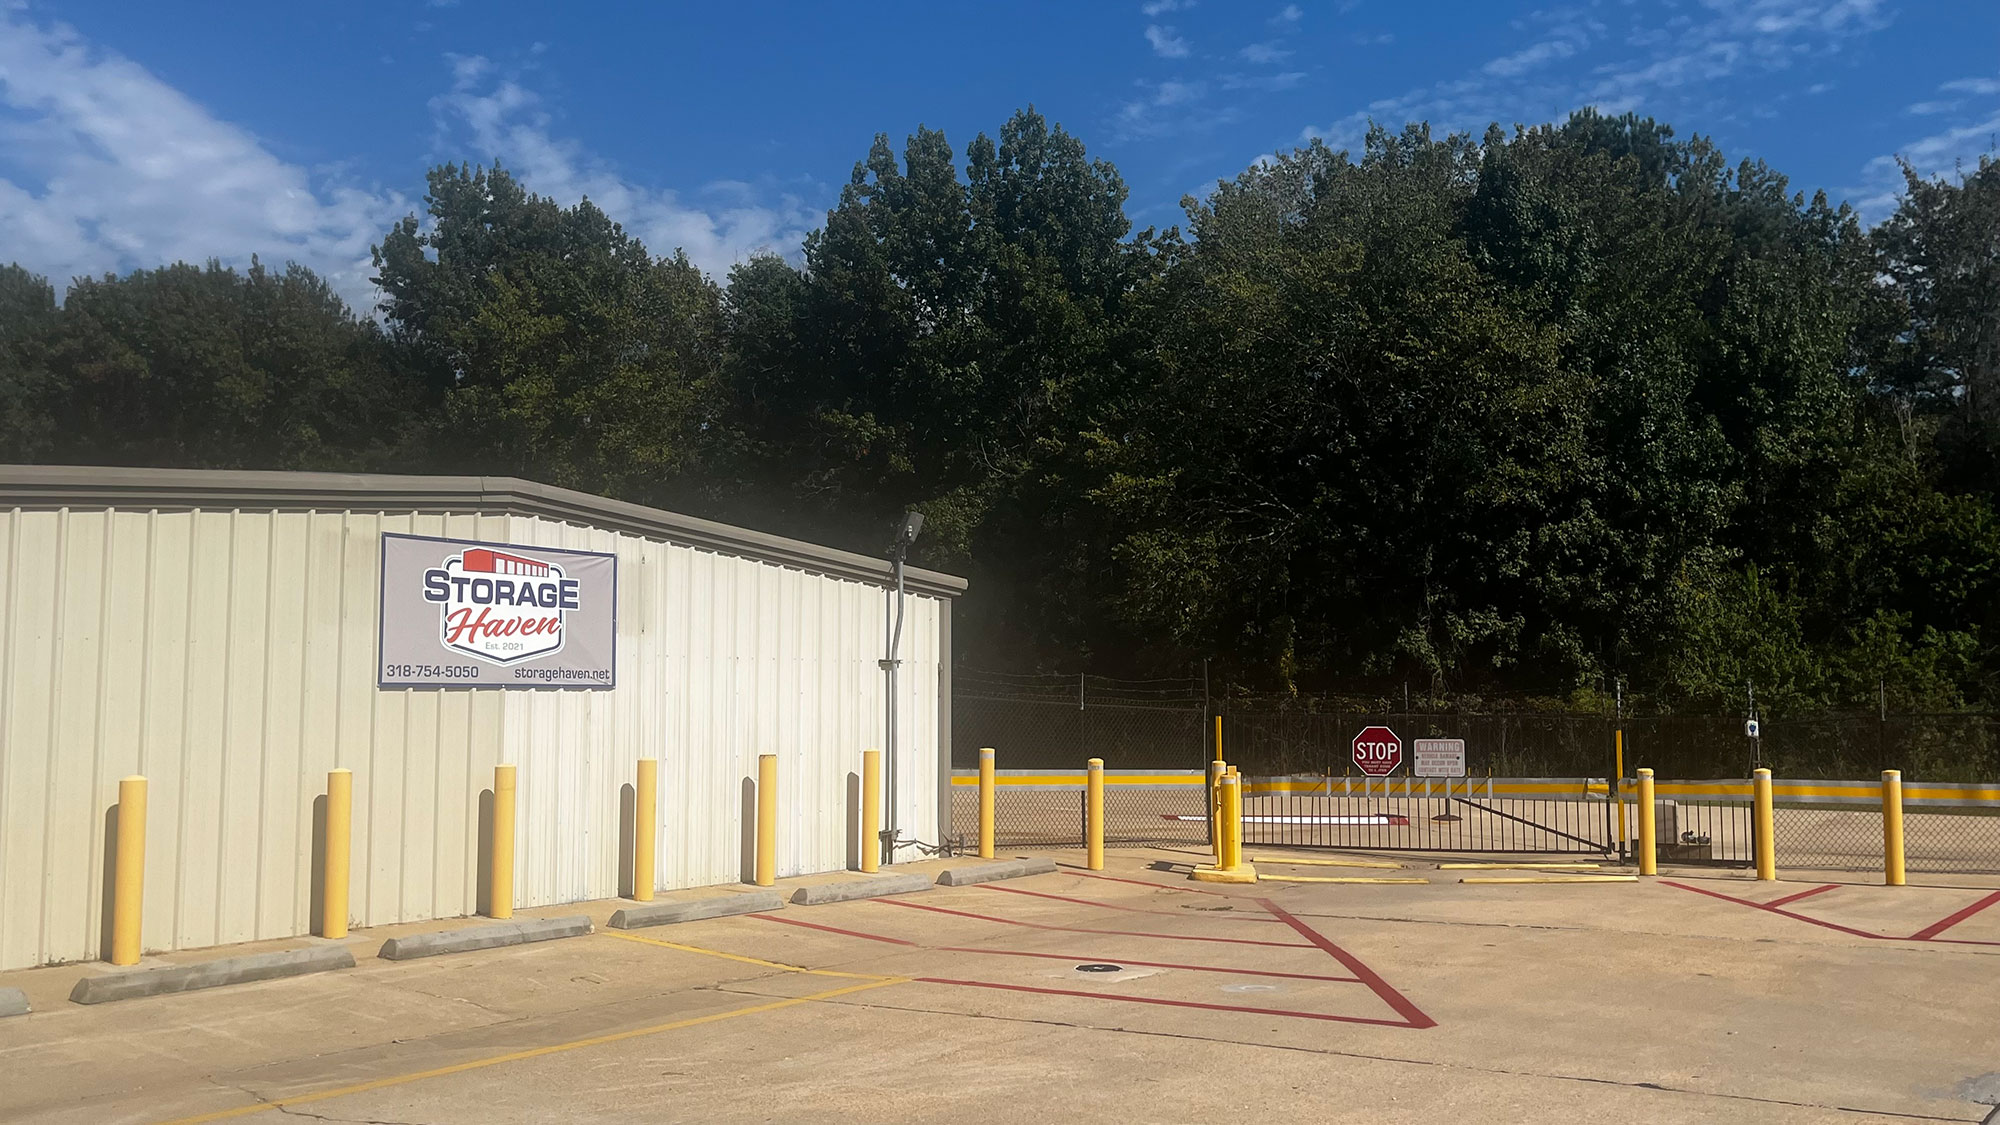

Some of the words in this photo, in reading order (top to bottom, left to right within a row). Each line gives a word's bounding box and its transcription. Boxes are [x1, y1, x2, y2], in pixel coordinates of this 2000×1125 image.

[424, 569, 579, 609] STORAGE
[446, 606, 561, 644] Haven
[485, 642, 500, 650] Est.
[502, 643, 524, 651] 2021
[386, 664, 479, 678] 318-754-5050
[514, 667, 610, 682] storagehaven.net
[1356, 742, 1398, 760] STOP
[1419, 742, 1460, 751] WARNING
